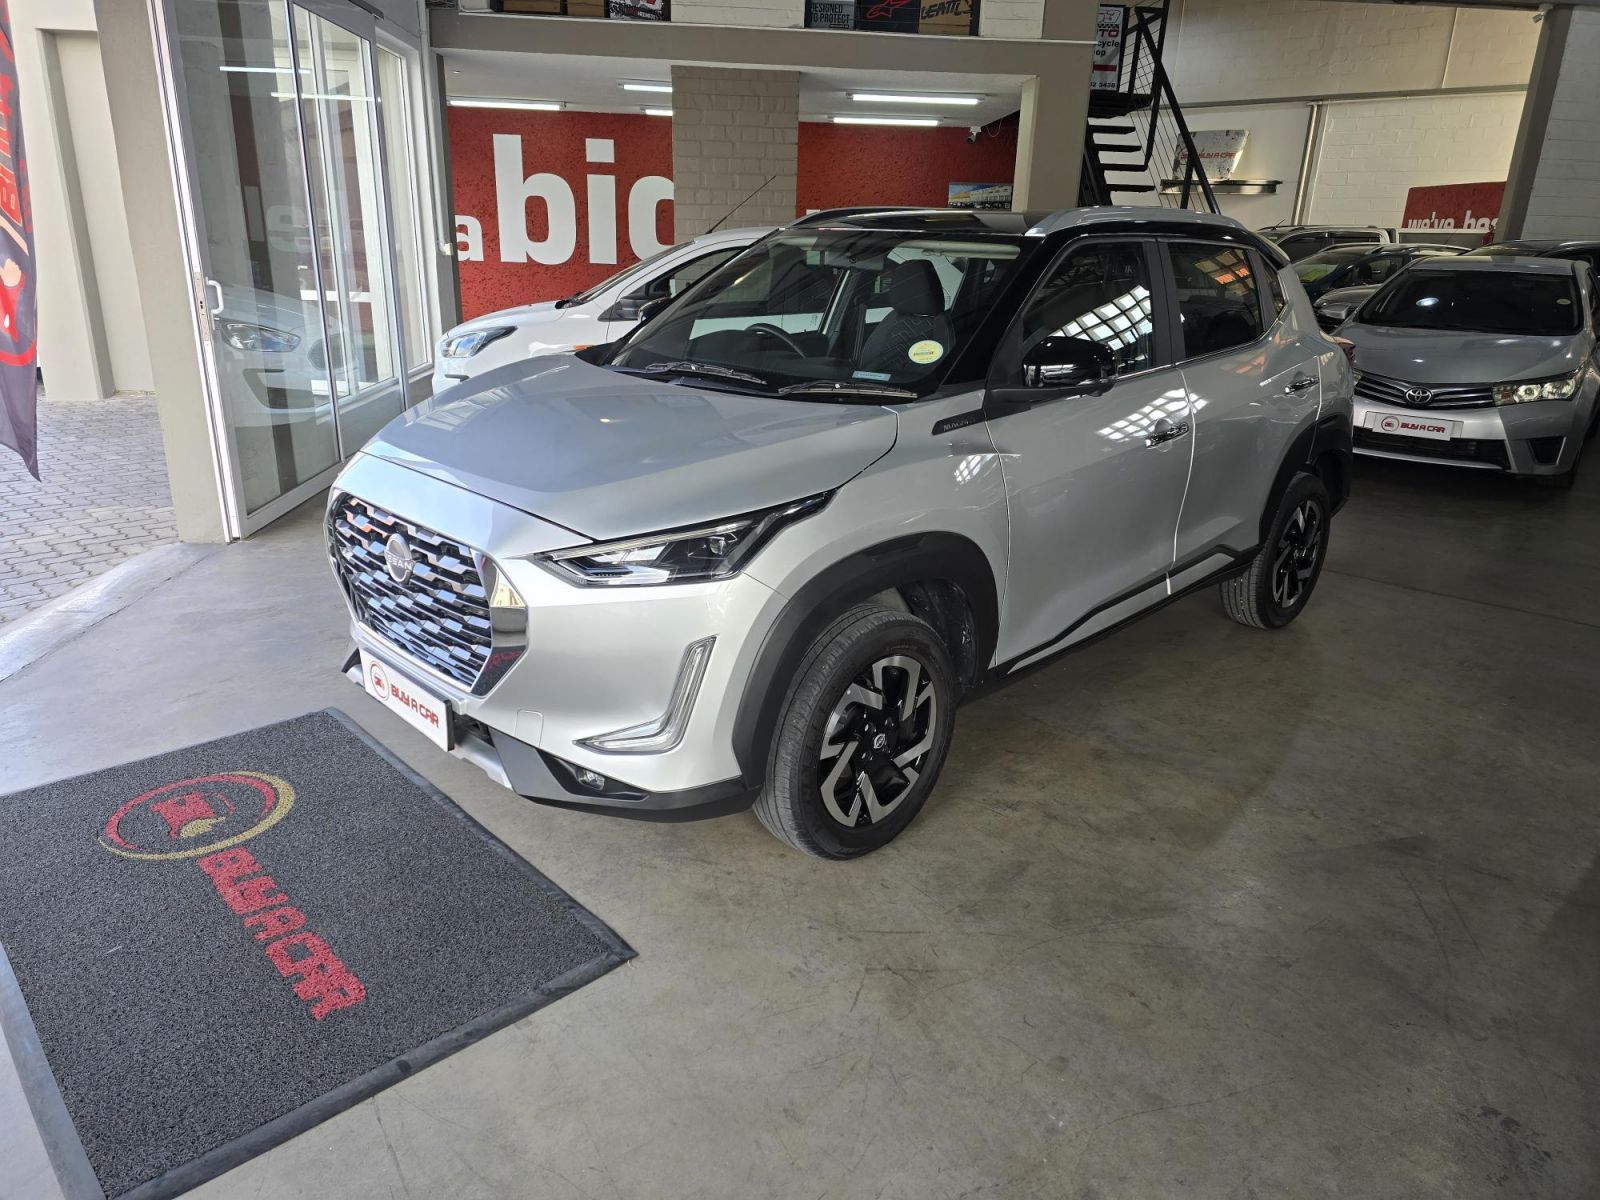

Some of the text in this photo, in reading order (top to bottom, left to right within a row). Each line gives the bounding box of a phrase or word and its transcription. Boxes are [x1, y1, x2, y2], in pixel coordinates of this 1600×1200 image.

[820, 13, 850, 24] PROTECT
[1400, 422, 1420, 431] BUY
[1426, 425, 1446, 434] CAR
[391, 683, 439, 728] BUY A CAR
[195, 846, 368, 1021] BUY A CAR
